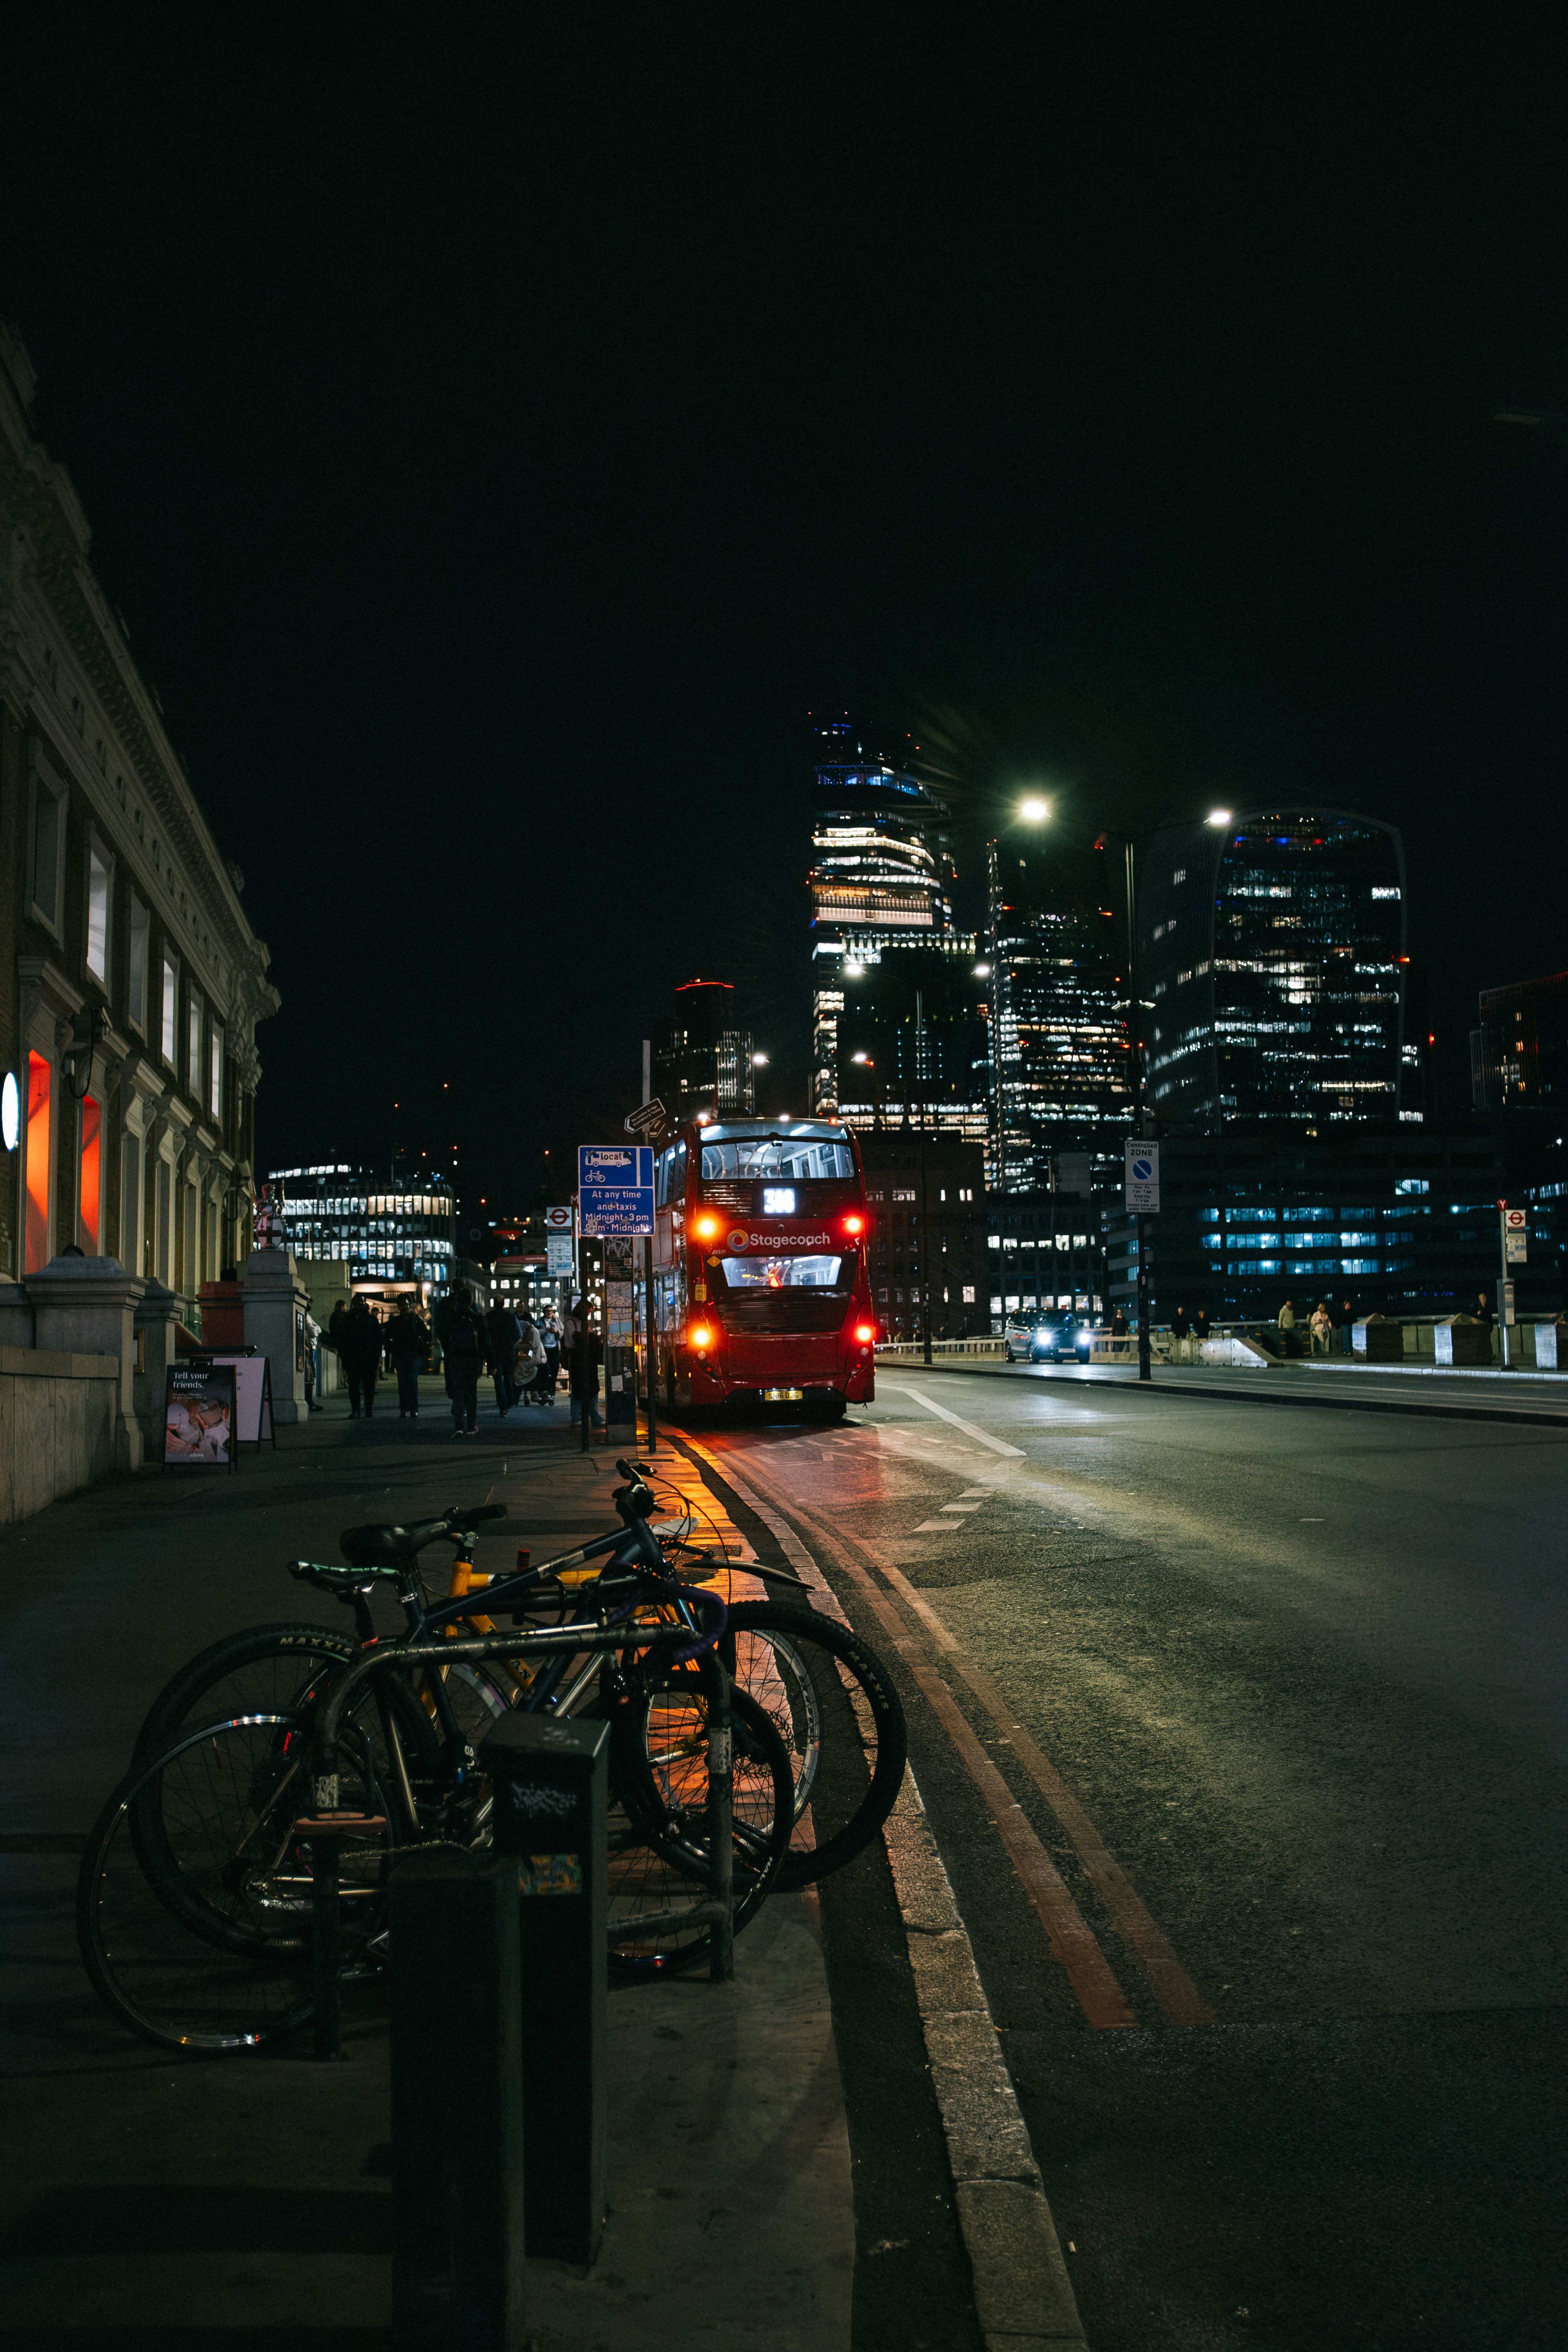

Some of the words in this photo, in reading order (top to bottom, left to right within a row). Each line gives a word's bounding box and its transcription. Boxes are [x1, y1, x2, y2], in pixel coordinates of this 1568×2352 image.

[1500, 1200, 1506, 1209] Y
[750, 1232, 830, 1248] Stagecoach
[191, 1373, 209, 1381] your
[173, 1381, 204, 1389] friends,
[279, 1637, 352, 1655] MAXXIS
[847, 1651, 889, 1709] MAXXIS
